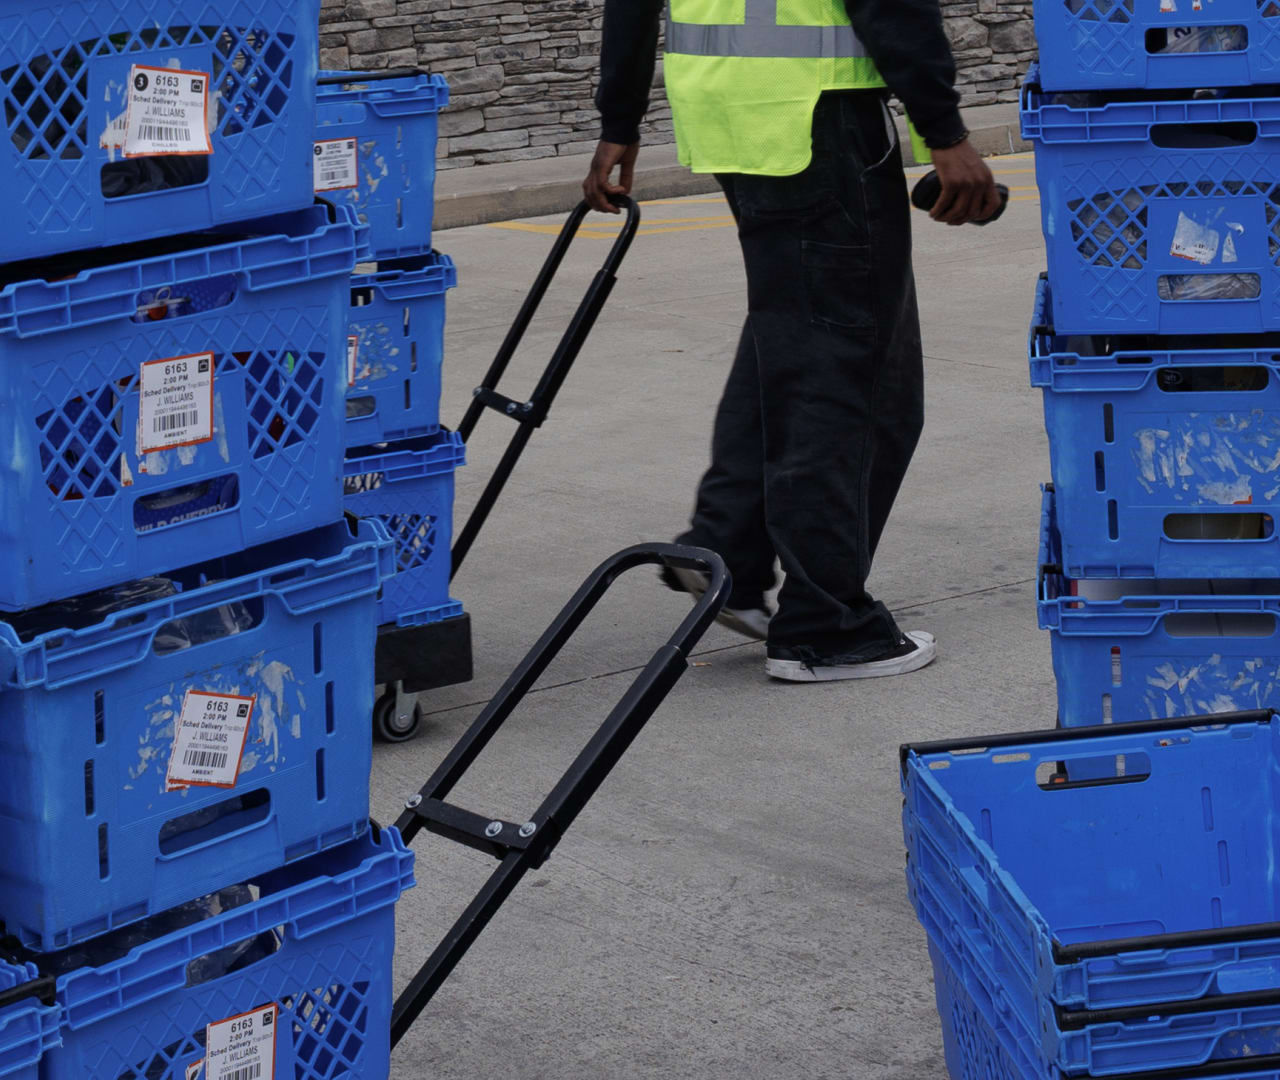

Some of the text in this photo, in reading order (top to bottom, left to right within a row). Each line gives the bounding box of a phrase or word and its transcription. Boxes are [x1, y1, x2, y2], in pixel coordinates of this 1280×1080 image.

[156, 75, 179, 87] 6163
[153, 97, 176, 106] Delivery
[152, 107, 185, 118] WILLIAMS
[165, 362, 187, 375] 6163
[164, 377, 176, 385] 2:00
[144, 386, 186, 397] Sched Delivery
[164, 392, 194, 405] WILLIAMS
[164, 430, 187, 438] AMBIENT
[207, 701, 228, 712] 6163
[201, 722, 222, 731] Delivery
[199, 732, 228, 743] WILLIAMS
[231, 1018, 253, 1032] 6163
[244, 1029, 253, 1038] PM
[210, 1040, 251, 1057] Sched Delivery
[229, 1046, 258, 1062] WILLIAMS
